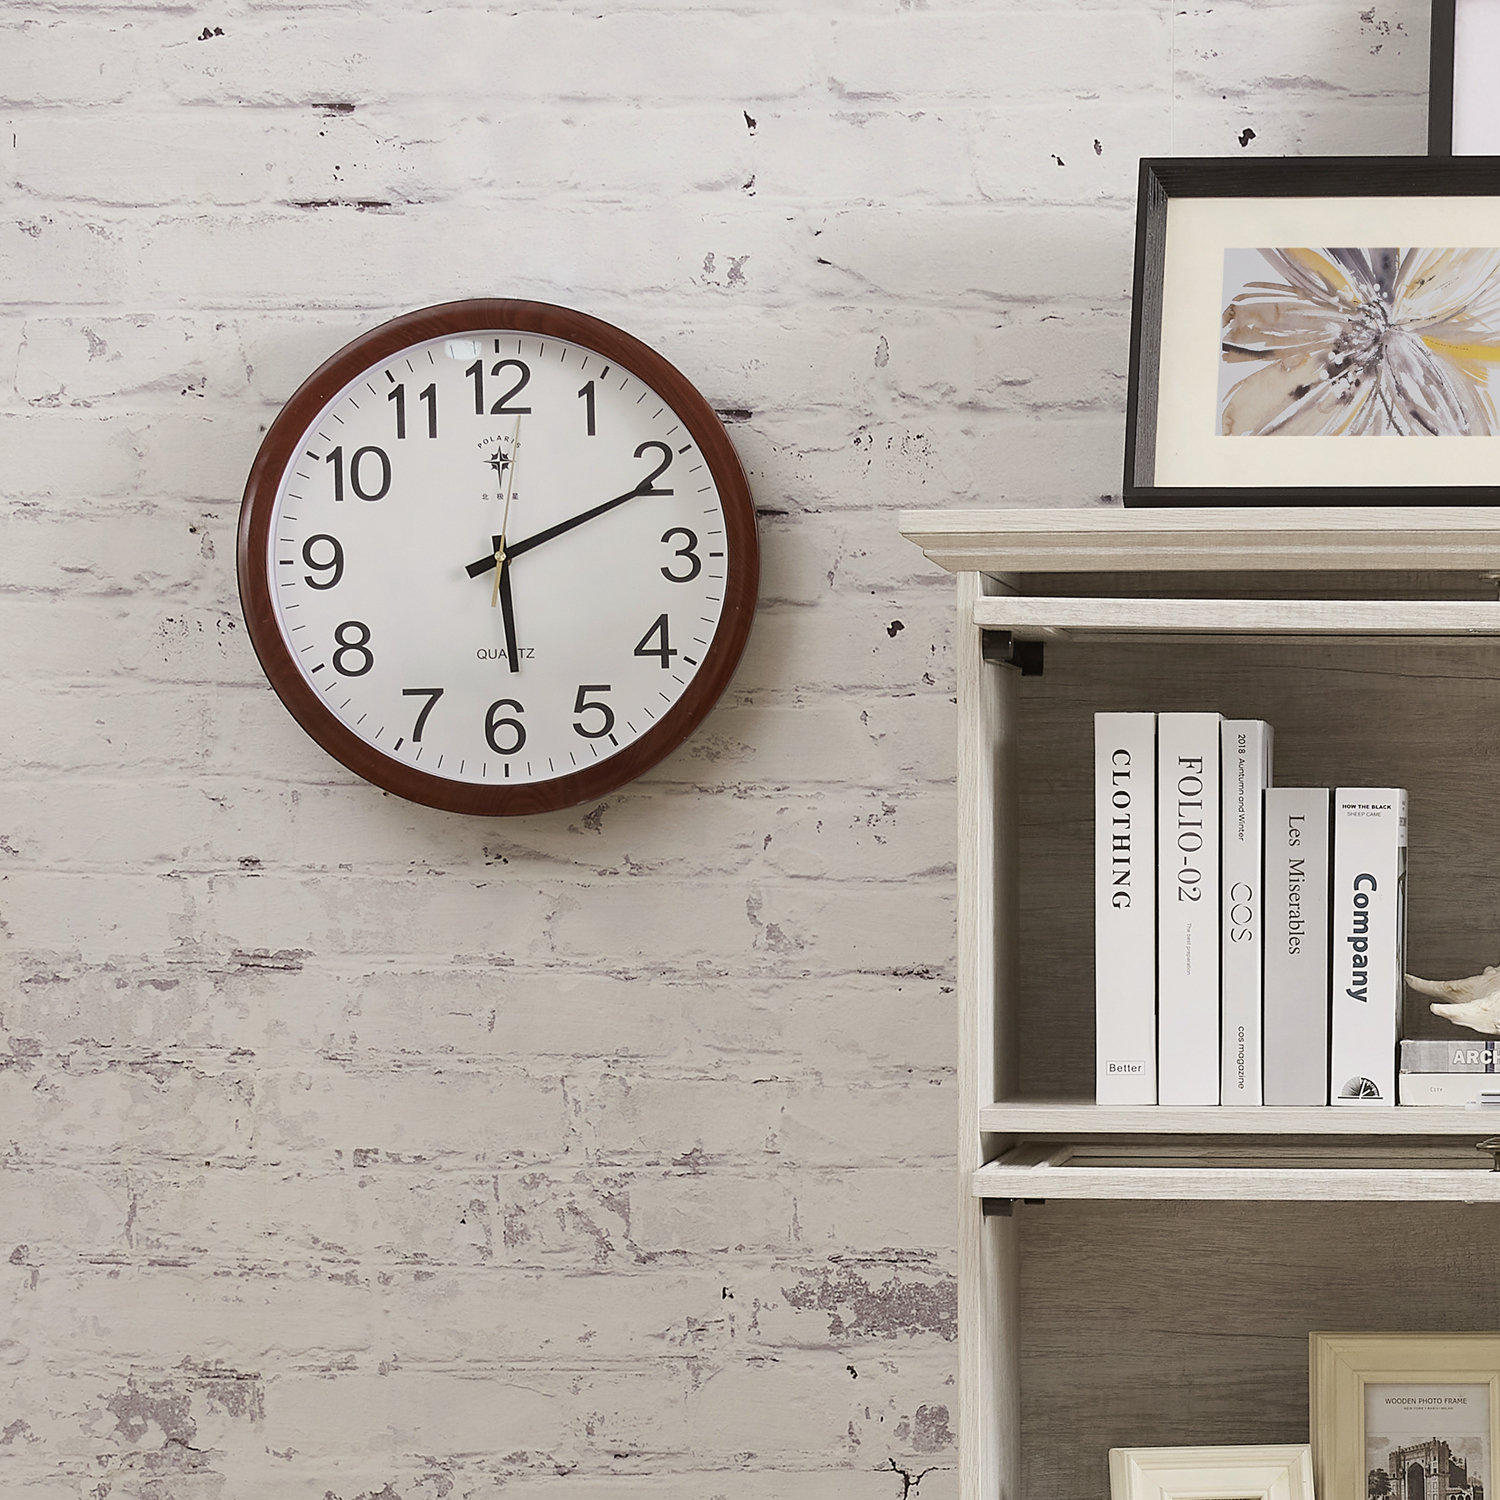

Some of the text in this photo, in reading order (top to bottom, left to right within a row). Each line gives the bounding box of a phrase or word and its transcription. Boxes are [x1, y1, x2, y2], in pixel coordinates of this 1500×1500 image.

[388, 383, 438, 439] 11
[466, 359, 531, 414] 12
[578, 381, 595, 436] 1
[477, 435, 521, 449] POLARIS
[633, 441, 674, 497] 2
[326, 446, 391, 501] 10
[302, 534, 344, 590] 9
[661, 527, 701, 583] 3
[333, 621, 373, 677] 8
[476, 648, 535, 660] QUATZ
[634, 614, 677, 669] 4
[401, 688, 444, 742] 7
[485, 699, 526, 755] 6
[572, 684, 615, 739] 5
[1238, 734, 1246, 754] 2018
[1112, 749, 1131, 908] CLOTHING
[1178, 756, 1203, 901] FOLIO-02
[1231, 883, 1252, 942] COS
[1289, 816, 1305, 954] Les Miserables
[1346, 873, 1377, 1002] Company
[1109, 1062, 1142, 1074] Better
[1236, 1044, 1245, 1089] magazine
